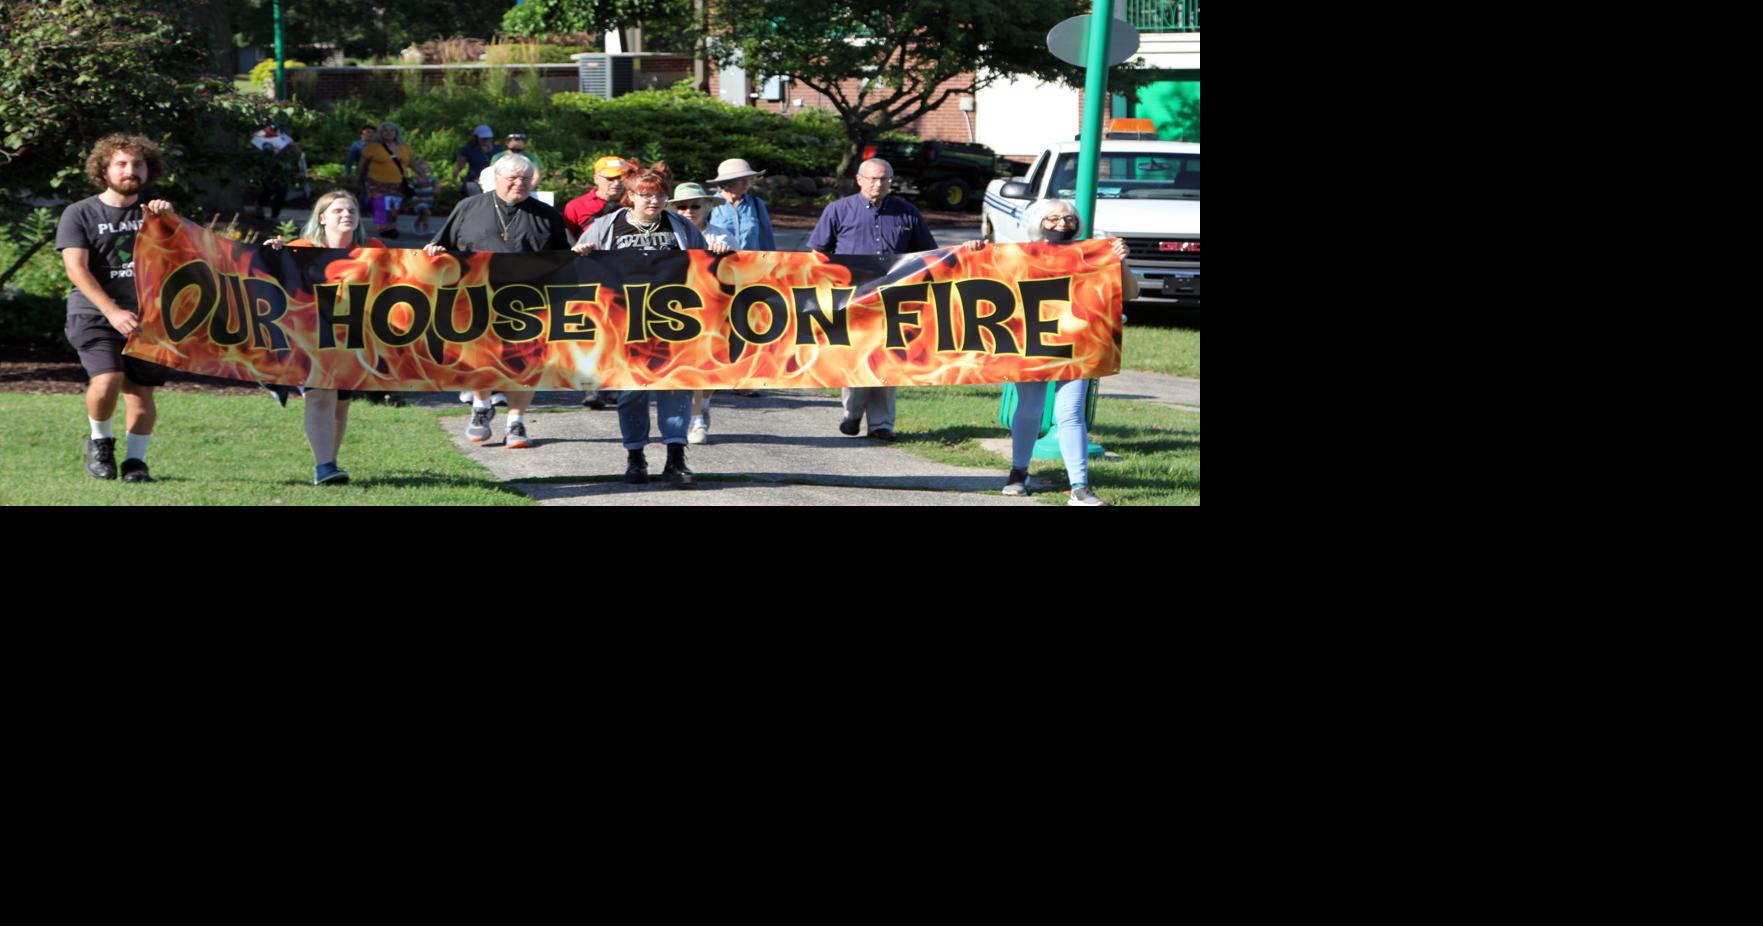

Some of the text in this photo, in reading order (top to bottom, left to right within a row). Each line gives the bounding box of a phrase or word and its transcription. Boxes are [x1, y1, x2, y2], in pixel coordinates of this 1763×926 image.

[159, 259, 1076, 359] OUR HOUSE IS ON FIRE
